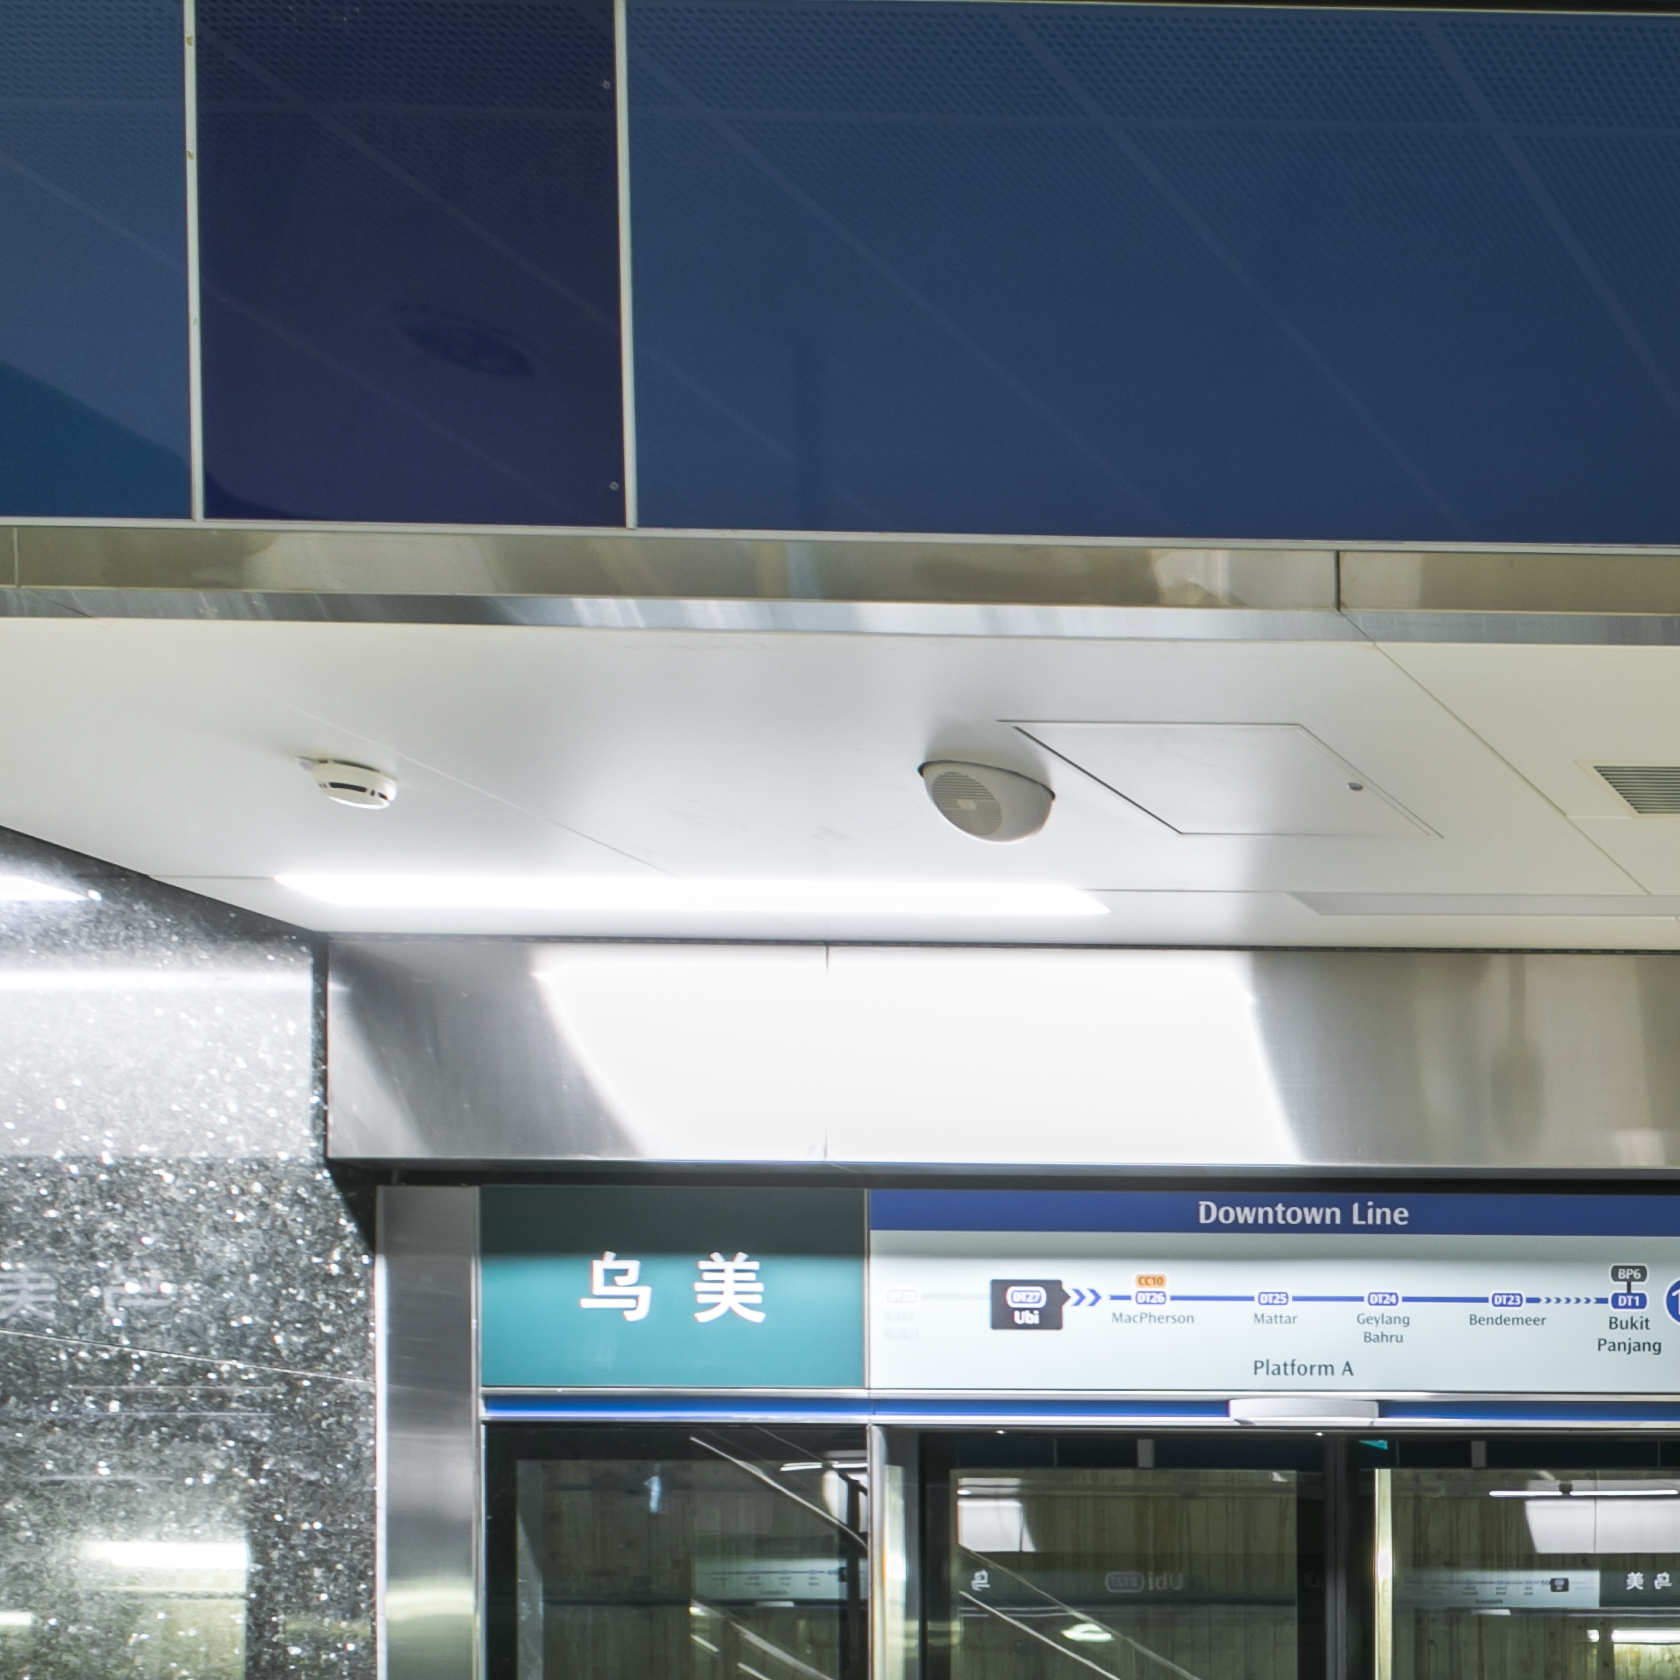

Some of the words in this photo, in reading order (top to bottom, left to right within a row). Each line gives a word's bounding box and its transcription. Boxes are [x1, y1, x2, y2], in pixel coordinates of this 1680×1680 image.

[1198, 1200, 1341, 1226] Downtown
[1351, 1200, 1410, 1226] Line
[1617, 1268, 1642, 1280] BP6
[579, 1251, 767, 1323] 乌美
[1137, 1276, 1164, 1287] CC10
[1012, 1290, 1041, 1303] DT27
[1136, 1292, 1166, 1304] DT26
[1259, 1293, 1288, 1305] DT25
[1369, 1293, 1397, 1305] DT24
[1493, 1294, 1522, 1306] DT23
[1617, 1295, 1640, 1307] DT1
[1013, 1310, 1040, 1325] Ubi
[1111, 1311, 1195, 1324] MacPherson
[1253, 1312, 1298, 1325] Mattar
[1356, 1312, 1411, 1328] Geylang
[1469, 1313, 1547, 1326] Bendemeer
[1608, 1315, 1651, 1331] Bukit
[1363, 1331, 1404, 1344] Bahru
[1597, 1337, 1662, 1356] Panjang
[1253, 1358, 1335, 1377] Platform
[1341, 1361, 1354, 1377] A
